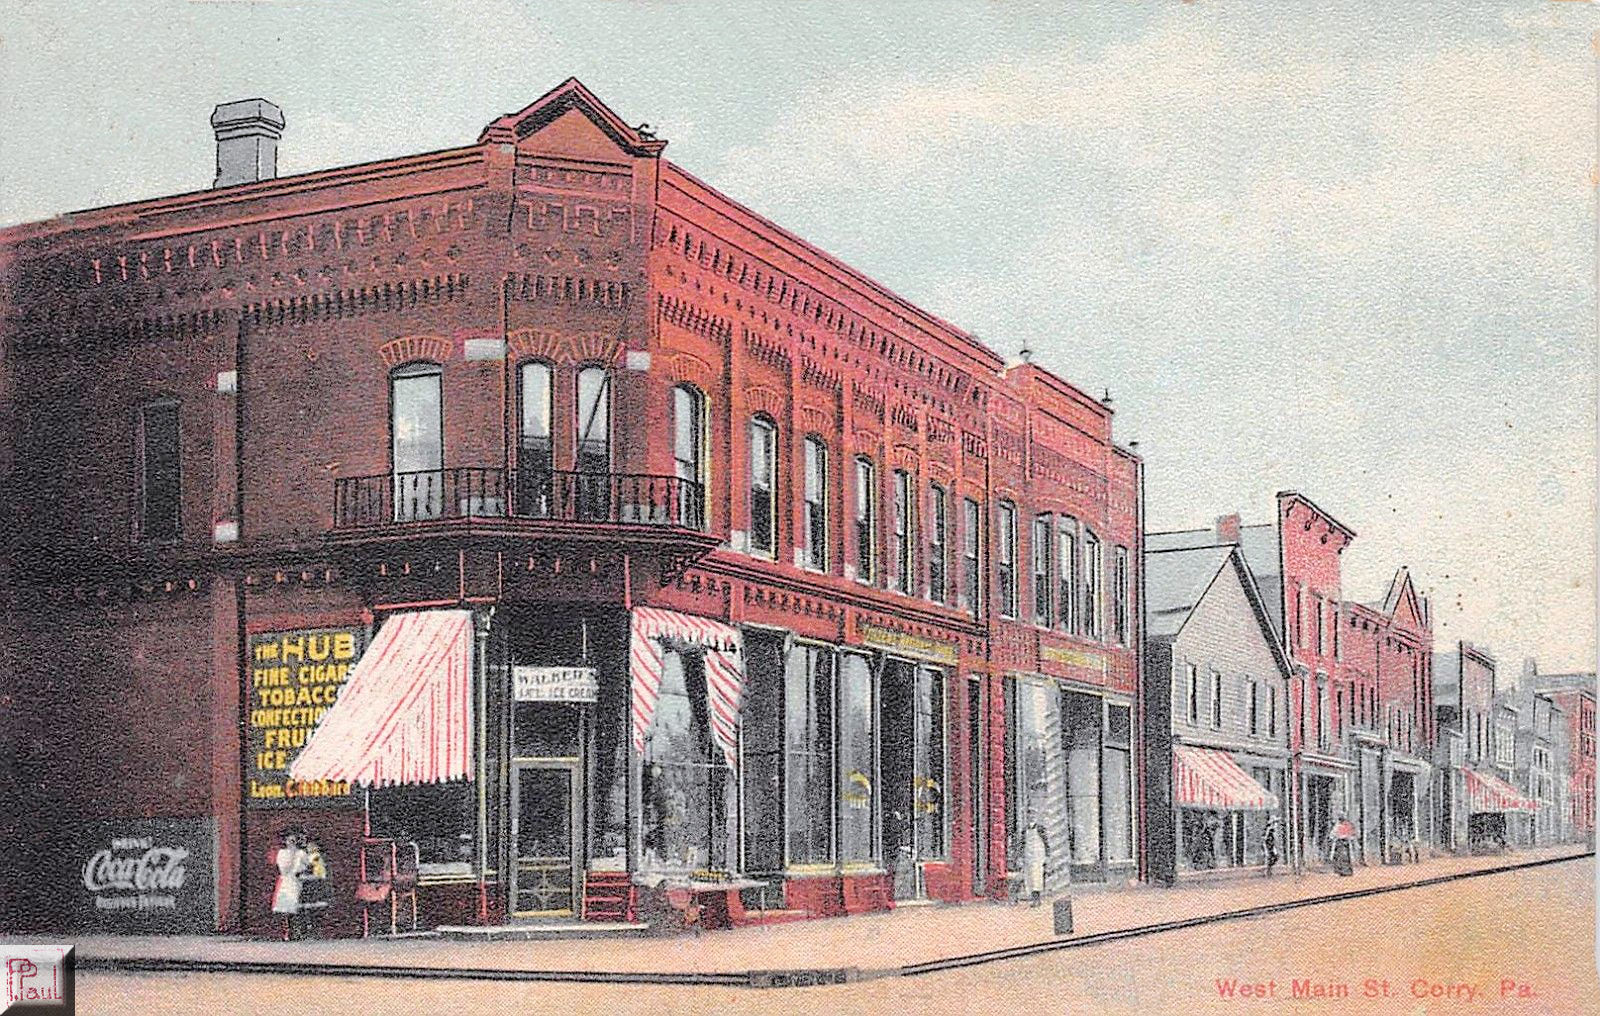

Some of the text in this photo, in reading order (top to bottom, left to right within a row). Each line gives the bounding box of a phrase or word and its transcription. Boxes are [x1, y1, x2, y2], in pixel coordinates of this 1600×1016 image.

[282, 634, 354, 663] HUB
[254, 667, 288, 687] FINE
[257, 751, 287, 769] ICE
